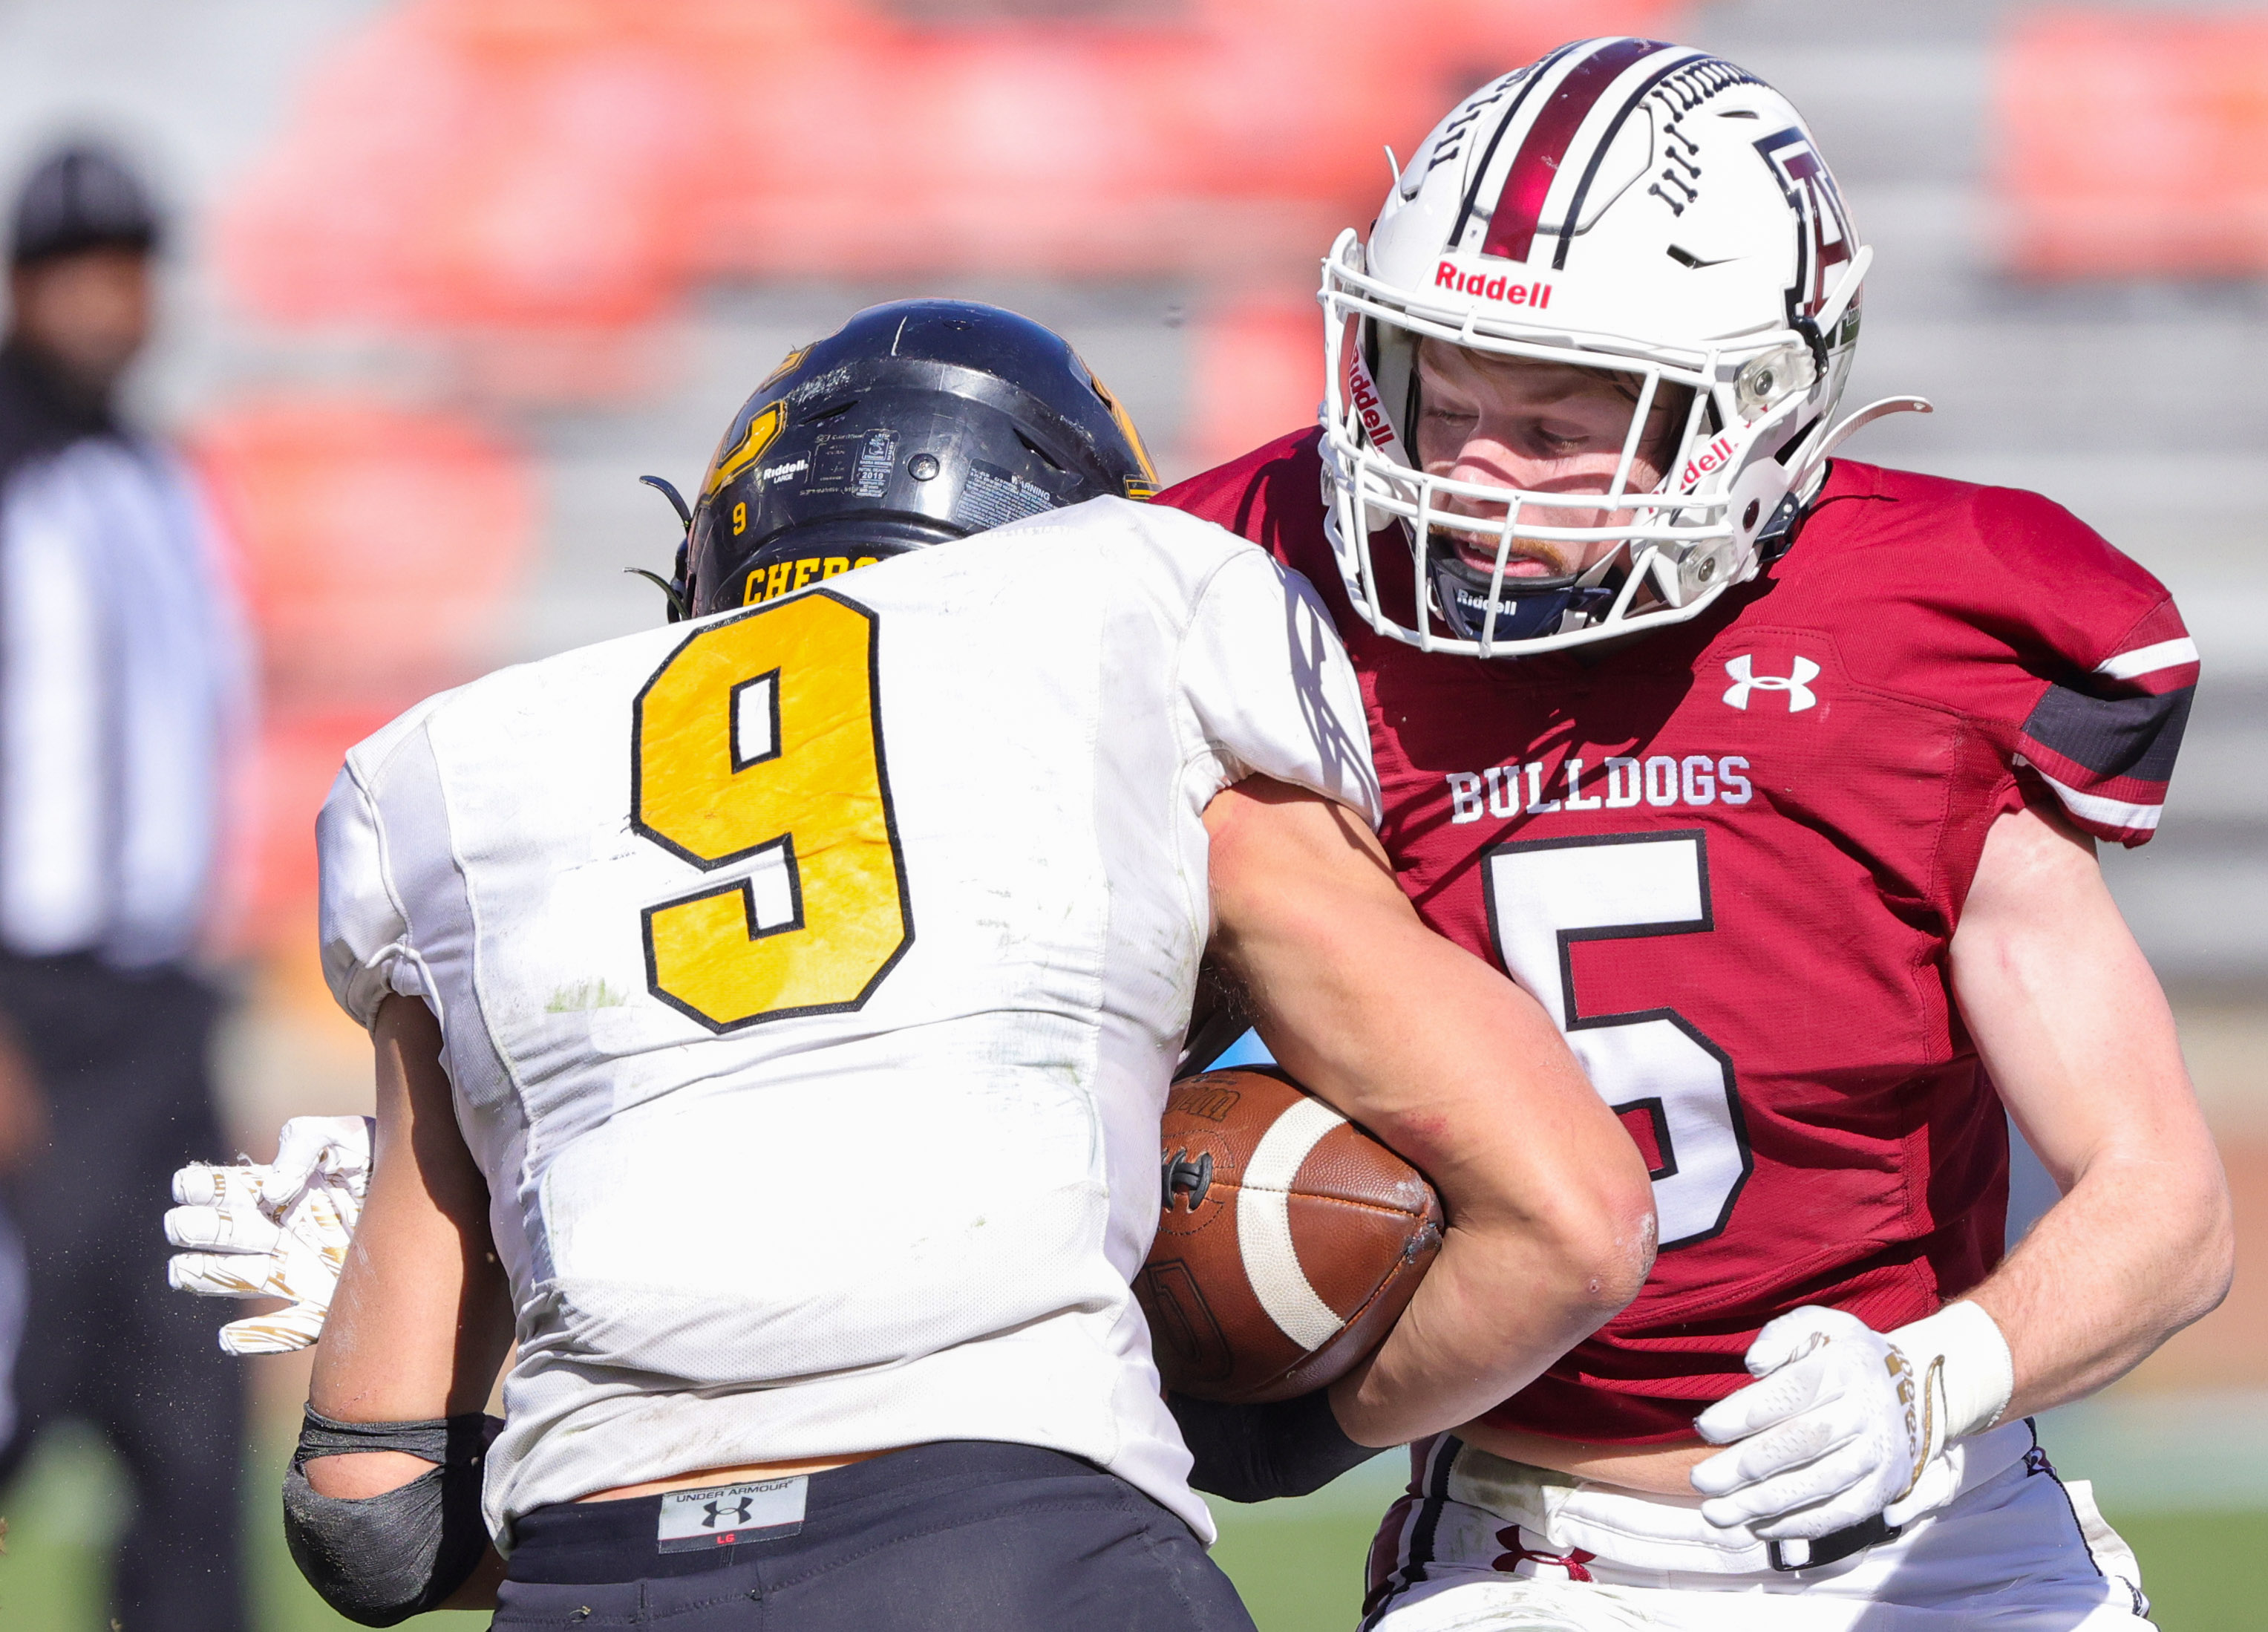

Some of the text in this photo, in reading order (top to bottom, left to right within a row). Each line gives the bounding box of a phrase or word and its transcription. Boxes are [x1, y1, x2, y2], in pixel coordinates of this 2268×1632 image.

[1435, 261, 1552, 309] Riddell
[763, 460, 806, 480] Riddell
[774, 473, 794, 484] LARGE
[862, 471, 883, 480] 2019
[733, 502, 747, 536] 9
[1445, 755, 1753, 824] BULLDOGS
[631, 587, 915, 1034] 9
[1480, 828, 1754, 1253] 5
[676, 1483, 788, 1503] UNDER ARMOUR
[716, 1533, 735, 1544] LG
